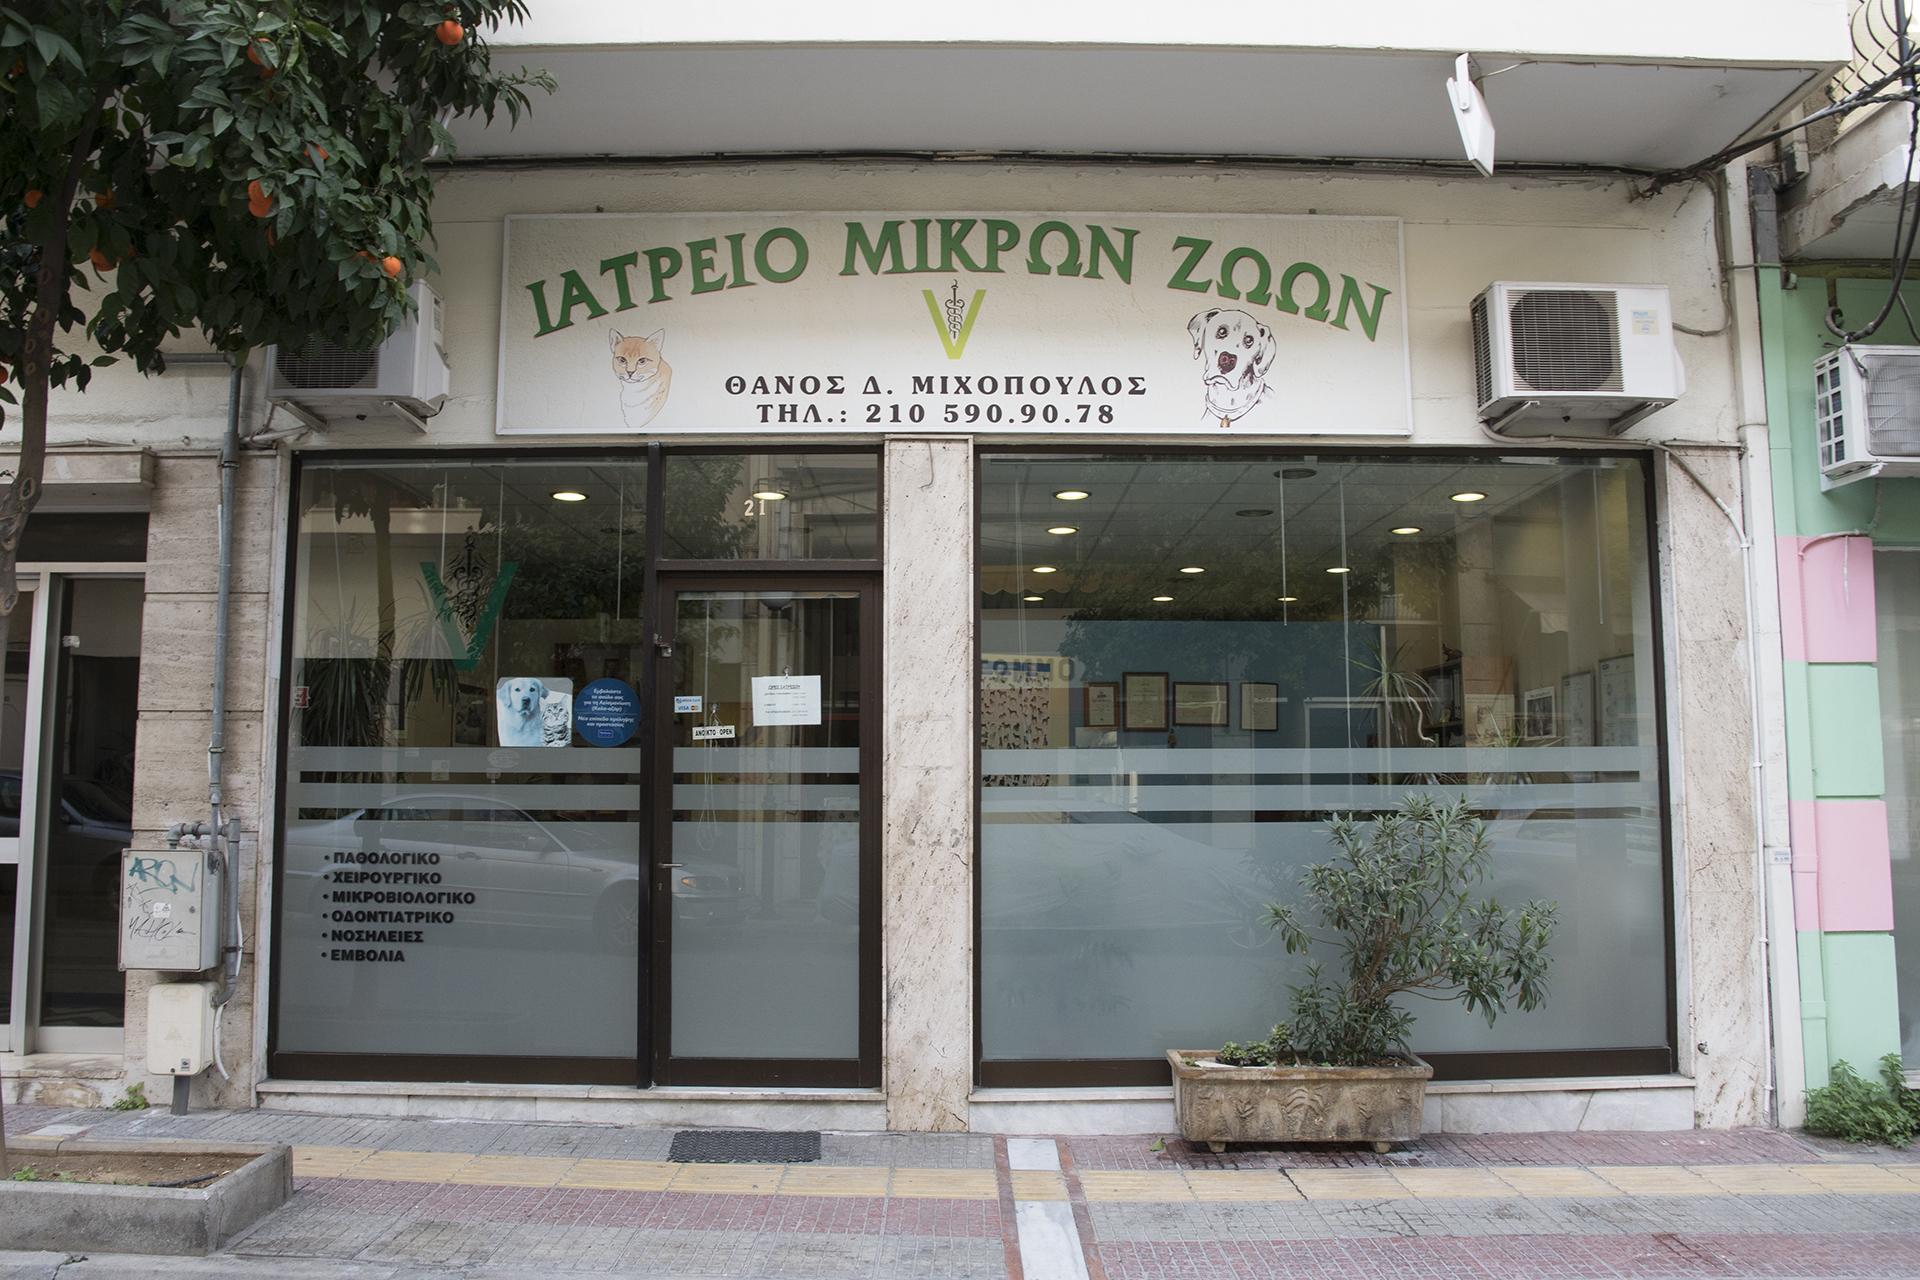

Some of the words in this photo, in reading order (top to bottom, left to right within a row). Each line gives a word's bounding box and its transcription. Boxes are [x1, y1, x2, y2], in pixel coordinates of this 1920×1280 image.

[526, 227, 808, 337] ΙΑΤΡΕΙΟ
[839, 219, 1140, 284] ΜΙΚΡΩΝ
[1168, 236, 1391, 341] ΖΩΩΝ
[725, 375, 845, 396] ΘΑΝΟΣ
[862, 375, 893, 395] Δ.
[912, 375, 1146, 396] ΜΙΧΟΠΟΥΛΟΣ
[756, 403, 847, 424] ΤΗΛ.:
[866, 403, 925, 423] 210
[943, 403, 1114, 424] 590.90.78
[744, 499, 766, 516] 21
[720, 728, 733, 736] OPEN
[333, 852, 440, 865] ΠΑΘΟΛΟΓΙΚΟ
[332, 871, 442, 884] ΧΕΙΡΟΥΡΓΙΚΟ
[332, 891, 476, 904] ΜΙΚΡΟΒΙΟΛΟΓΙΚΟ
[331, 910, 455, 924] ΟΔΟΝΤΙΑΤΡΙΚΟ
[331, 930, 424, 943] ΝΟΣΗΛΕΙΕΣ
[330, 949, 405, 962] ΕΜΒΟΛΙΑ
